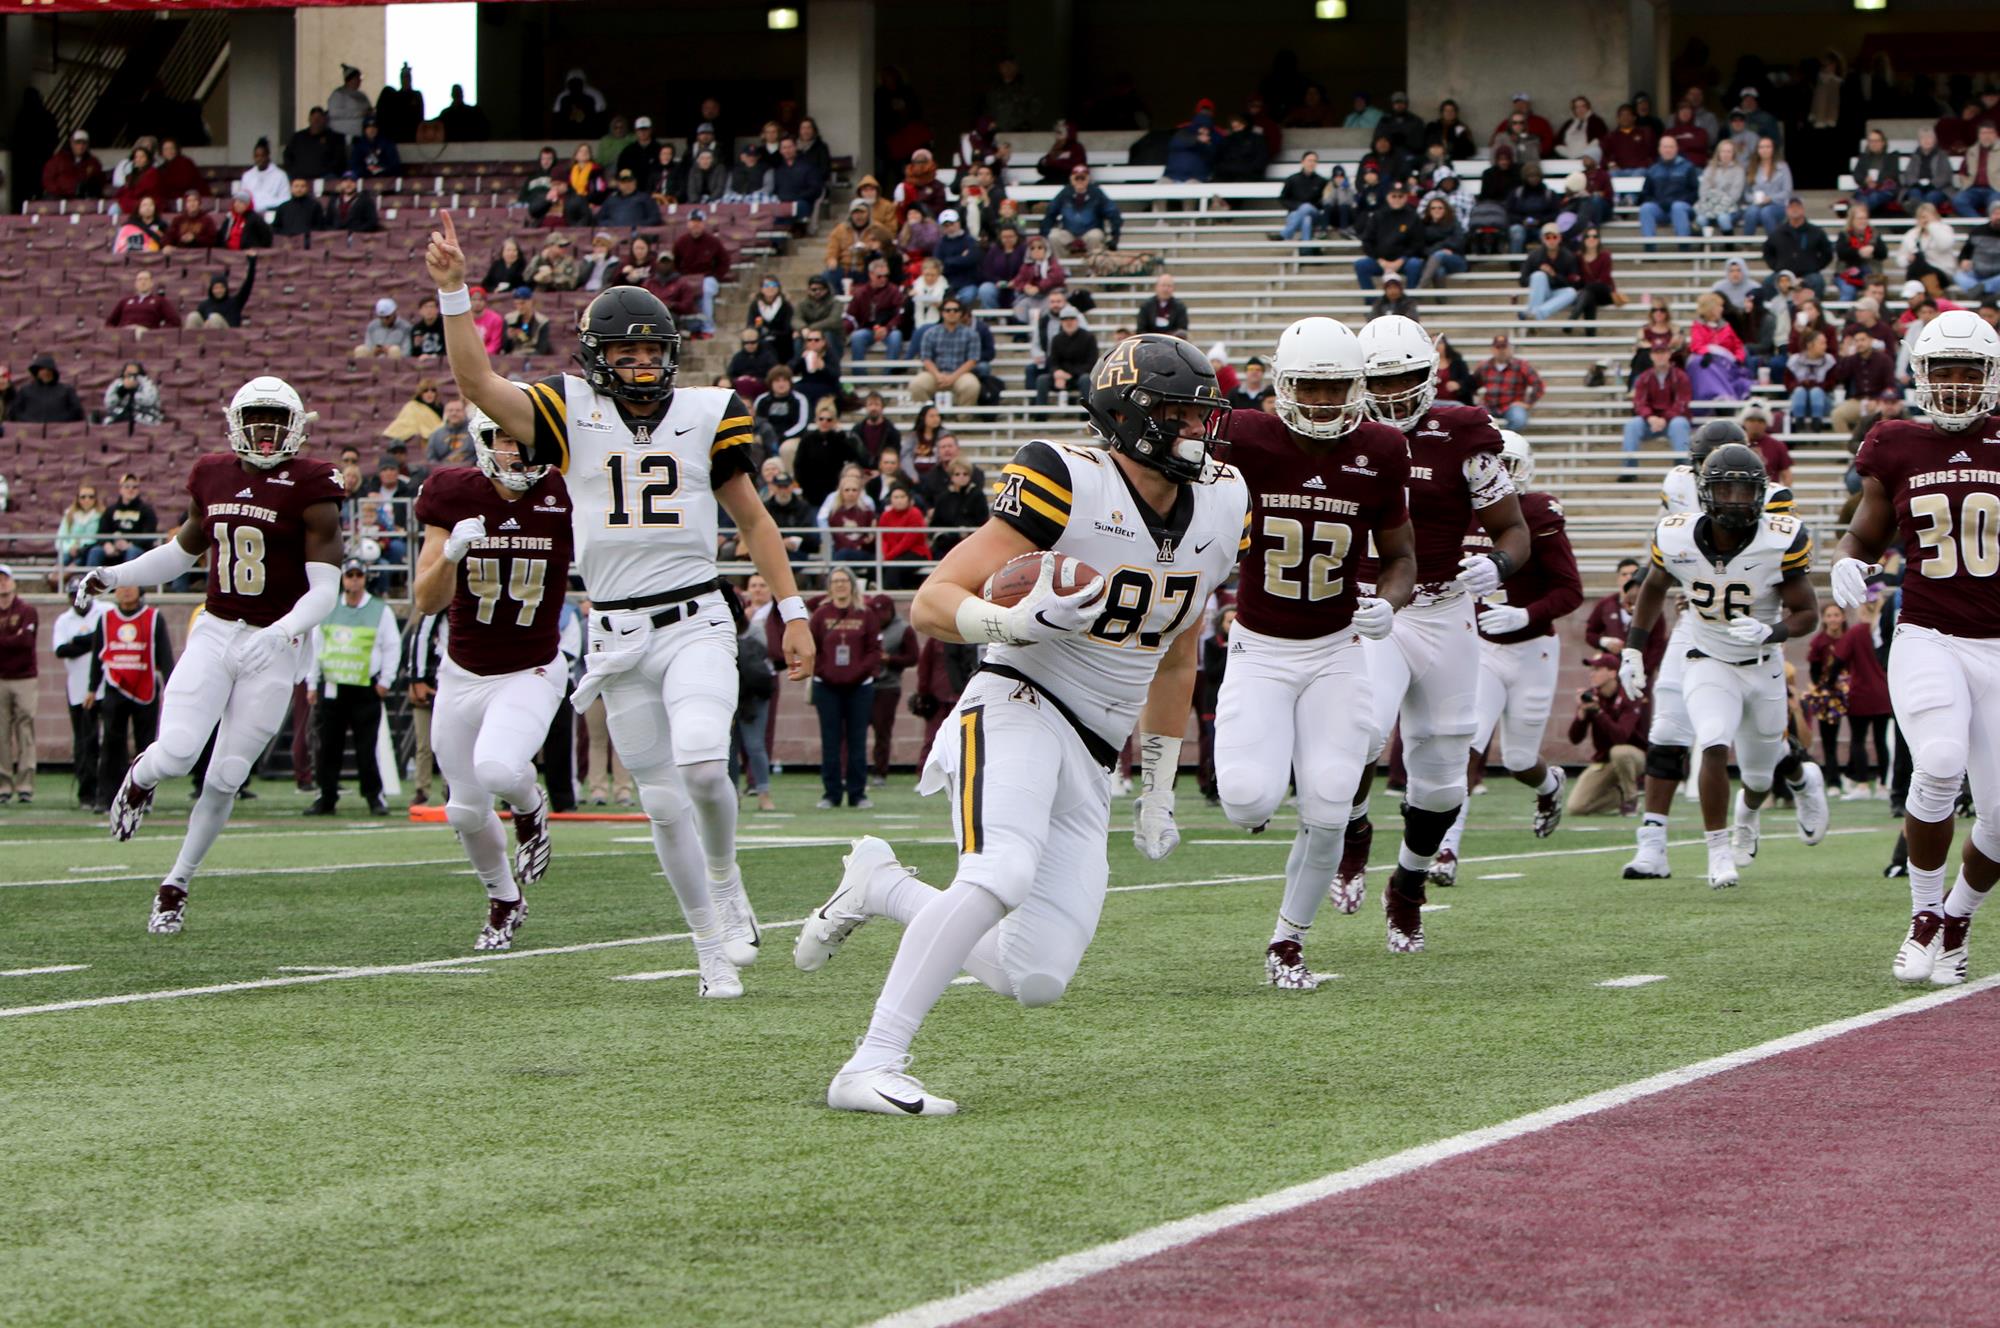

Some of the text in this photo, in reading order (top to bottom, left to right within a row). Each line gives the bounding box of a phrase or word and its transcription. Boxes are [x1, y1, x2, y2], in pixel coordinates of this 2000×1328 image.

[1097, 339, 1143, 390] A
[633, 426, 652, 445] A
[604, 451, 685, 528] 12
[993, 473, 1025, 517] A
[1909, 470, 1958, 489] TEXAS
[207, 503, 277, 523] TEXAS STATE
[1260, 493, 1360, 516] TEXAS STATE
[511, 536, 553, 550] STATE
[1094, 521, 1136, 538] SUN BELT
[1156, 538, 1175, 562] A
[1910, 492, 2000, 579] 30
[213, 522, 266, 596] 18
[1263, 515, 1353, 601] 22
[466, 556, 548, 627] 44
[1088, 564, 1201, 652] 87
[1689, 578, 1752, 622] 26
